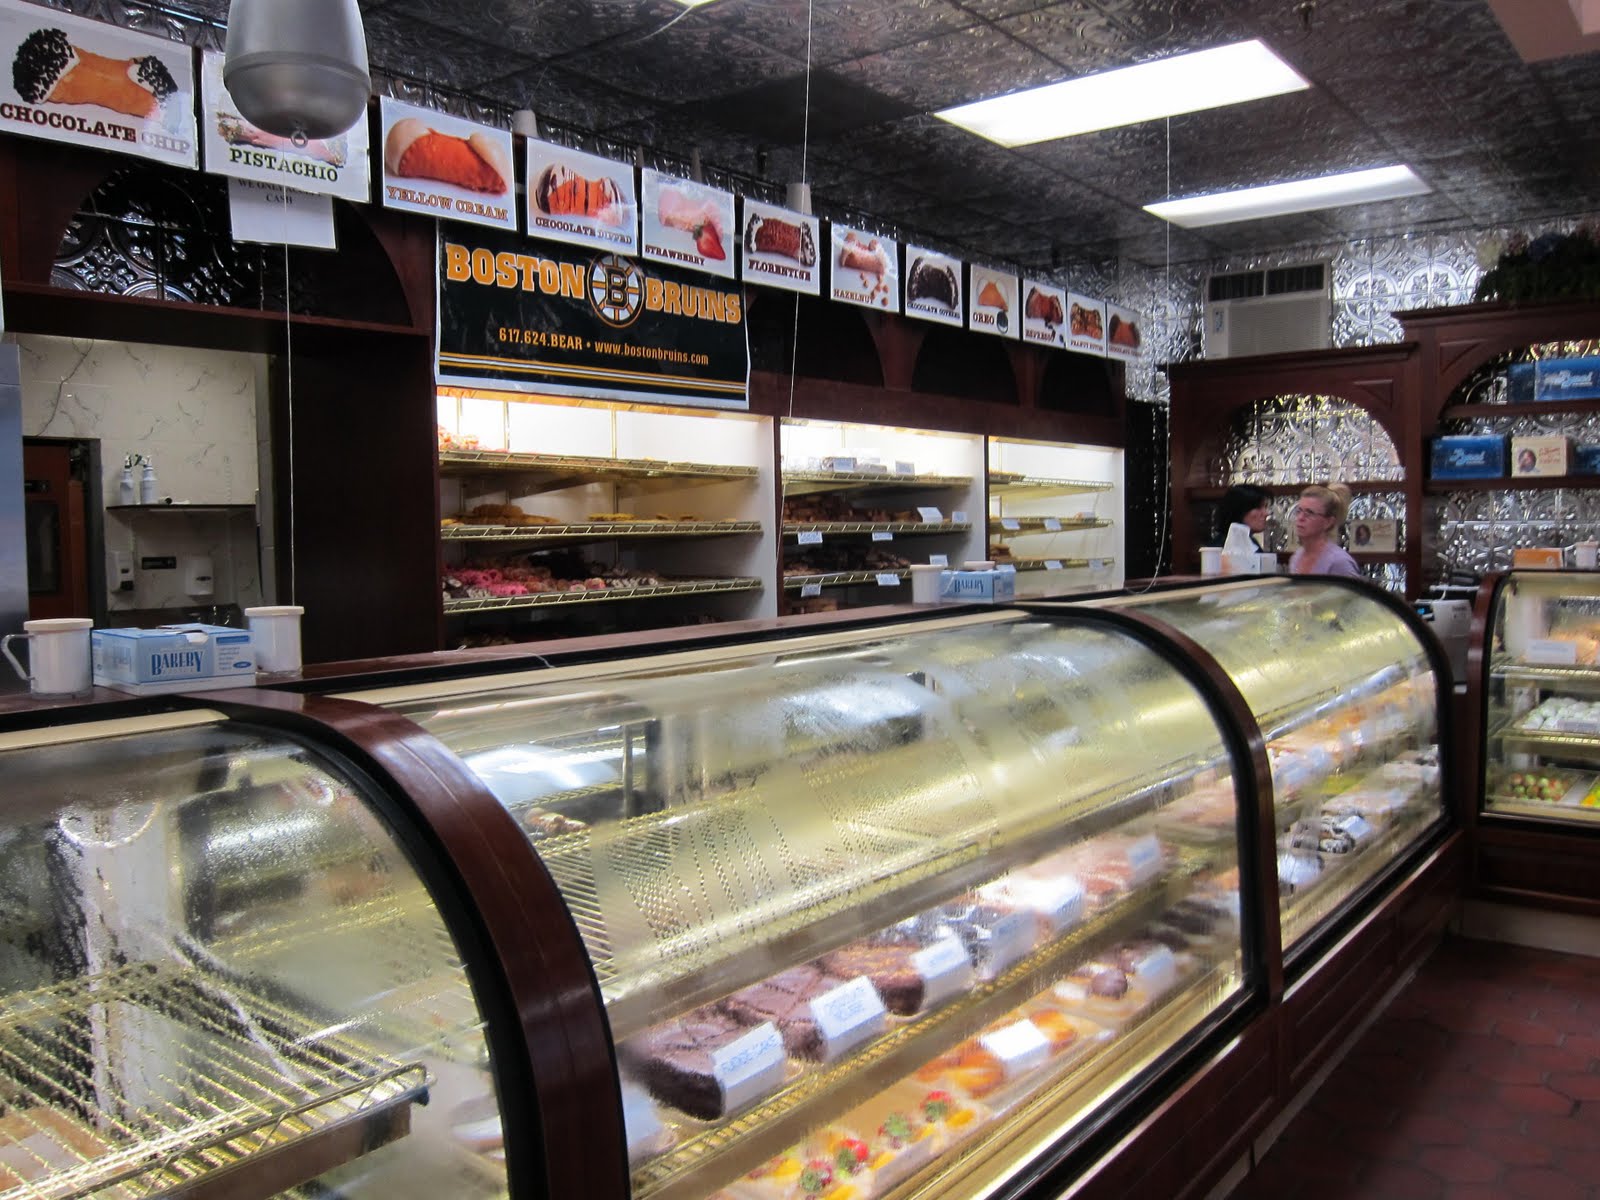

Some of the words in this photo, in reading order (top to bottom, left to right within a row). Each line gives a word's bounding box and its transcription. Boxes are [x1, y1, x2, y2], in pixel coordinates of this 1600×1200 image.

[0, 102, 137, 143] CHOCOLATE
[141, 132, 190, 154] CHIP
[229, 148, 338, 182] PISTACHIO
[266, 194, 293, 205] CASH
[386, 185, 453, 210] YELLOW
[455, 199, 508, 221] CREAM
[536, 217, 595, 237] CHOCOLATE
[645, 244, 705, 266] STRAWBERRY
[748, 258, 811, 282] FLORENTINE
[446, 242, 586, 300] BOSTON
[645, 277, 742, 325] BRUINS
[833, 288, 874, 304] HAZELNUT
[972, 312, 995, 325] OREO
[499, 327, 583, 351] 617.624.BEAR
[594, 340, 709, 365] www.bostonbruins.com
[954, 579, 984, 593] BAKERY
[152, 651, 203, 676] BAKERY
